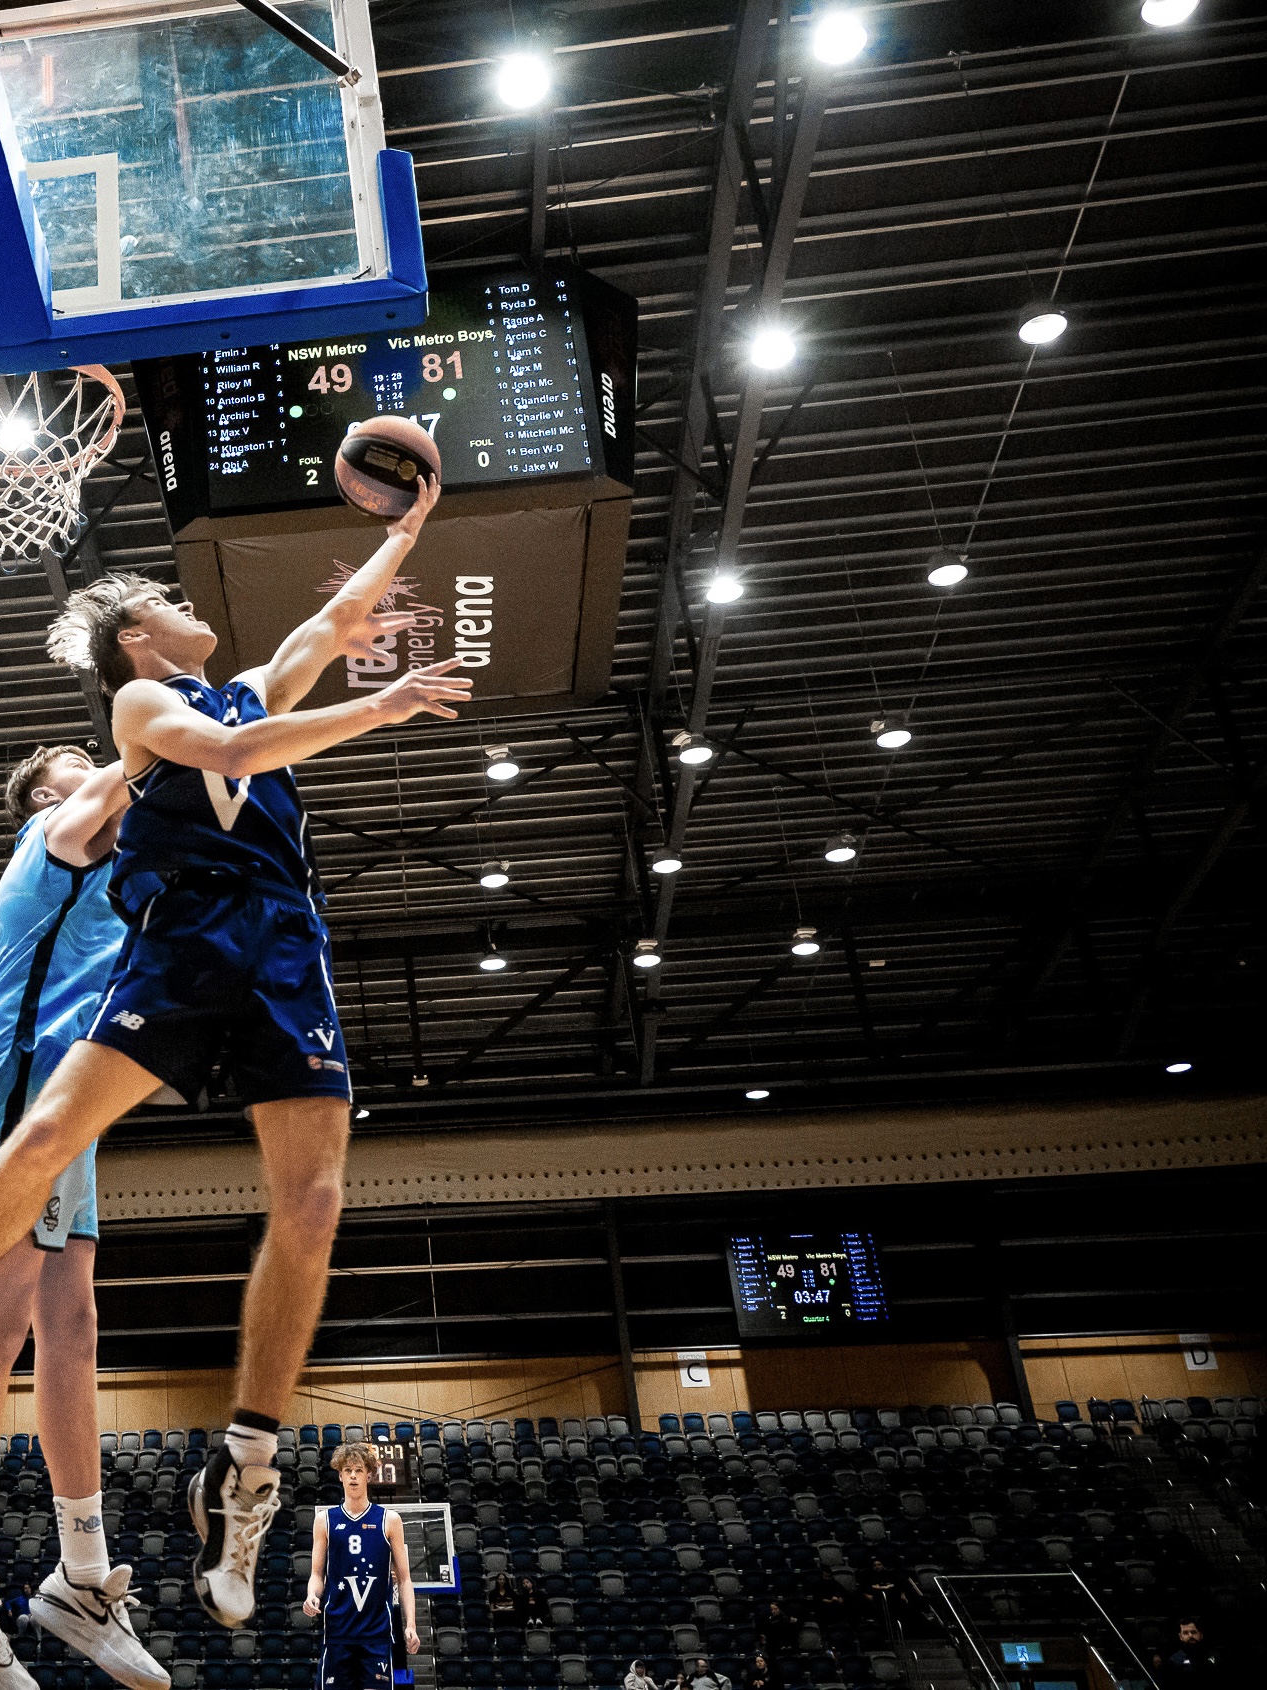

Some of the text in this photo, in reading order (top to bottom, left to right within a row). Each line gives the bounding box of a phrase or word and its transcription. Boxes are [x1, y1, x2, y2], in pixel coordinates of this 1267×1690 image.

[499, 286, 519, 294] Tom
[522, 284, 529, 292] D
[528, 299, 536, 307] D
[557, 294, 567, 302] 15
[537, 313, 545, 322] A
[388, 329, 493, 350] Vic Metro Boys
[505, 332, 537, 342] Archie
[539, 330, 547, 338] C
[566, 326, 572, 334] 2
[242, 347, 248, 356] J
[270, 343, 280, 351] 14
[288, 344, 367, 362] NSW Metro
[507, 348, 531, 358] Liam
[534, 346, 542, 355] K
[565, 342, 574, 350] 11
[216, 364, 250, 374] William
[253, 362, 261, 370] R
[421, 350, 463, 383] 81
[533, 362, 543, 371] M
[567, 358, 576, 366] 14
[243, 379, 252, 387] M
[307, 363, 353, 395] 49
[373, 374, 384, 382] 19
[498, 382, 508, 390] 10
[512, 380, 536, 390] Josh
[539, 378, 554, 387] Mc
[374, 383, 385, 392] 14
[392, 382, 403, 390] 17
[206, 398, 215, 406] 10
[218, 394, 256, 405] Antonio
[258, 393, 266, 402] B
[391, 392, 403, 400] 24
[500, 398, 509, 406] 11
[514, 394, 559, 406] Chandler
[562, 392, 569, 401] S
[393, 401, 404, 409] 12
[601, 372, 616, 439] arena
[219, 411, 250, 421] Archie
[252, 410, 259, 418] L
[502, 415, 513, 423] 12
[515, 411, 551, 422] Charlie
[553, 409, 564, 419] W
[220, 429, 240, 438] Max
[242, 427, 250, 435] V
[518, 428, 557, 439] Mitchell
[559, 426, 574, 435] Mc
[221, 442, 265, 454] Kingston
[267, 440, 274, 449] T
[281, 438, 286, 446] 7
[470, 439, 494, 448] FOUL
[506, 448, 516, 456] 14
[520, 447, 540, 456] Ben
[542, 443, 564, 454] W-D
[160, 430, 178, 492] arena
[242, 460, 249, 468] A
[299, 457, 322, 466] FOUL
[477, 451, 490, 467] 0
[509, 464, 519, 472] 15
[522, 463, 546, 473] Jake
[548, 461, 559, 470] W
[306, 469, 319, 486] 2
[454, 575, 494, 668] arena
[777, 1264, 795, 1278] 49
[820, 1262, 837, 1277] 81
[794, 1289, 831, 1304] 03:47
[780, 1311, 787, 1320] 2
[1190, 1344, 1209, 1366] D
[687, 1362, 703, 1383] C
[348, 1534, 362, 1555] 8
[344, 1575, 378, 1612] V
